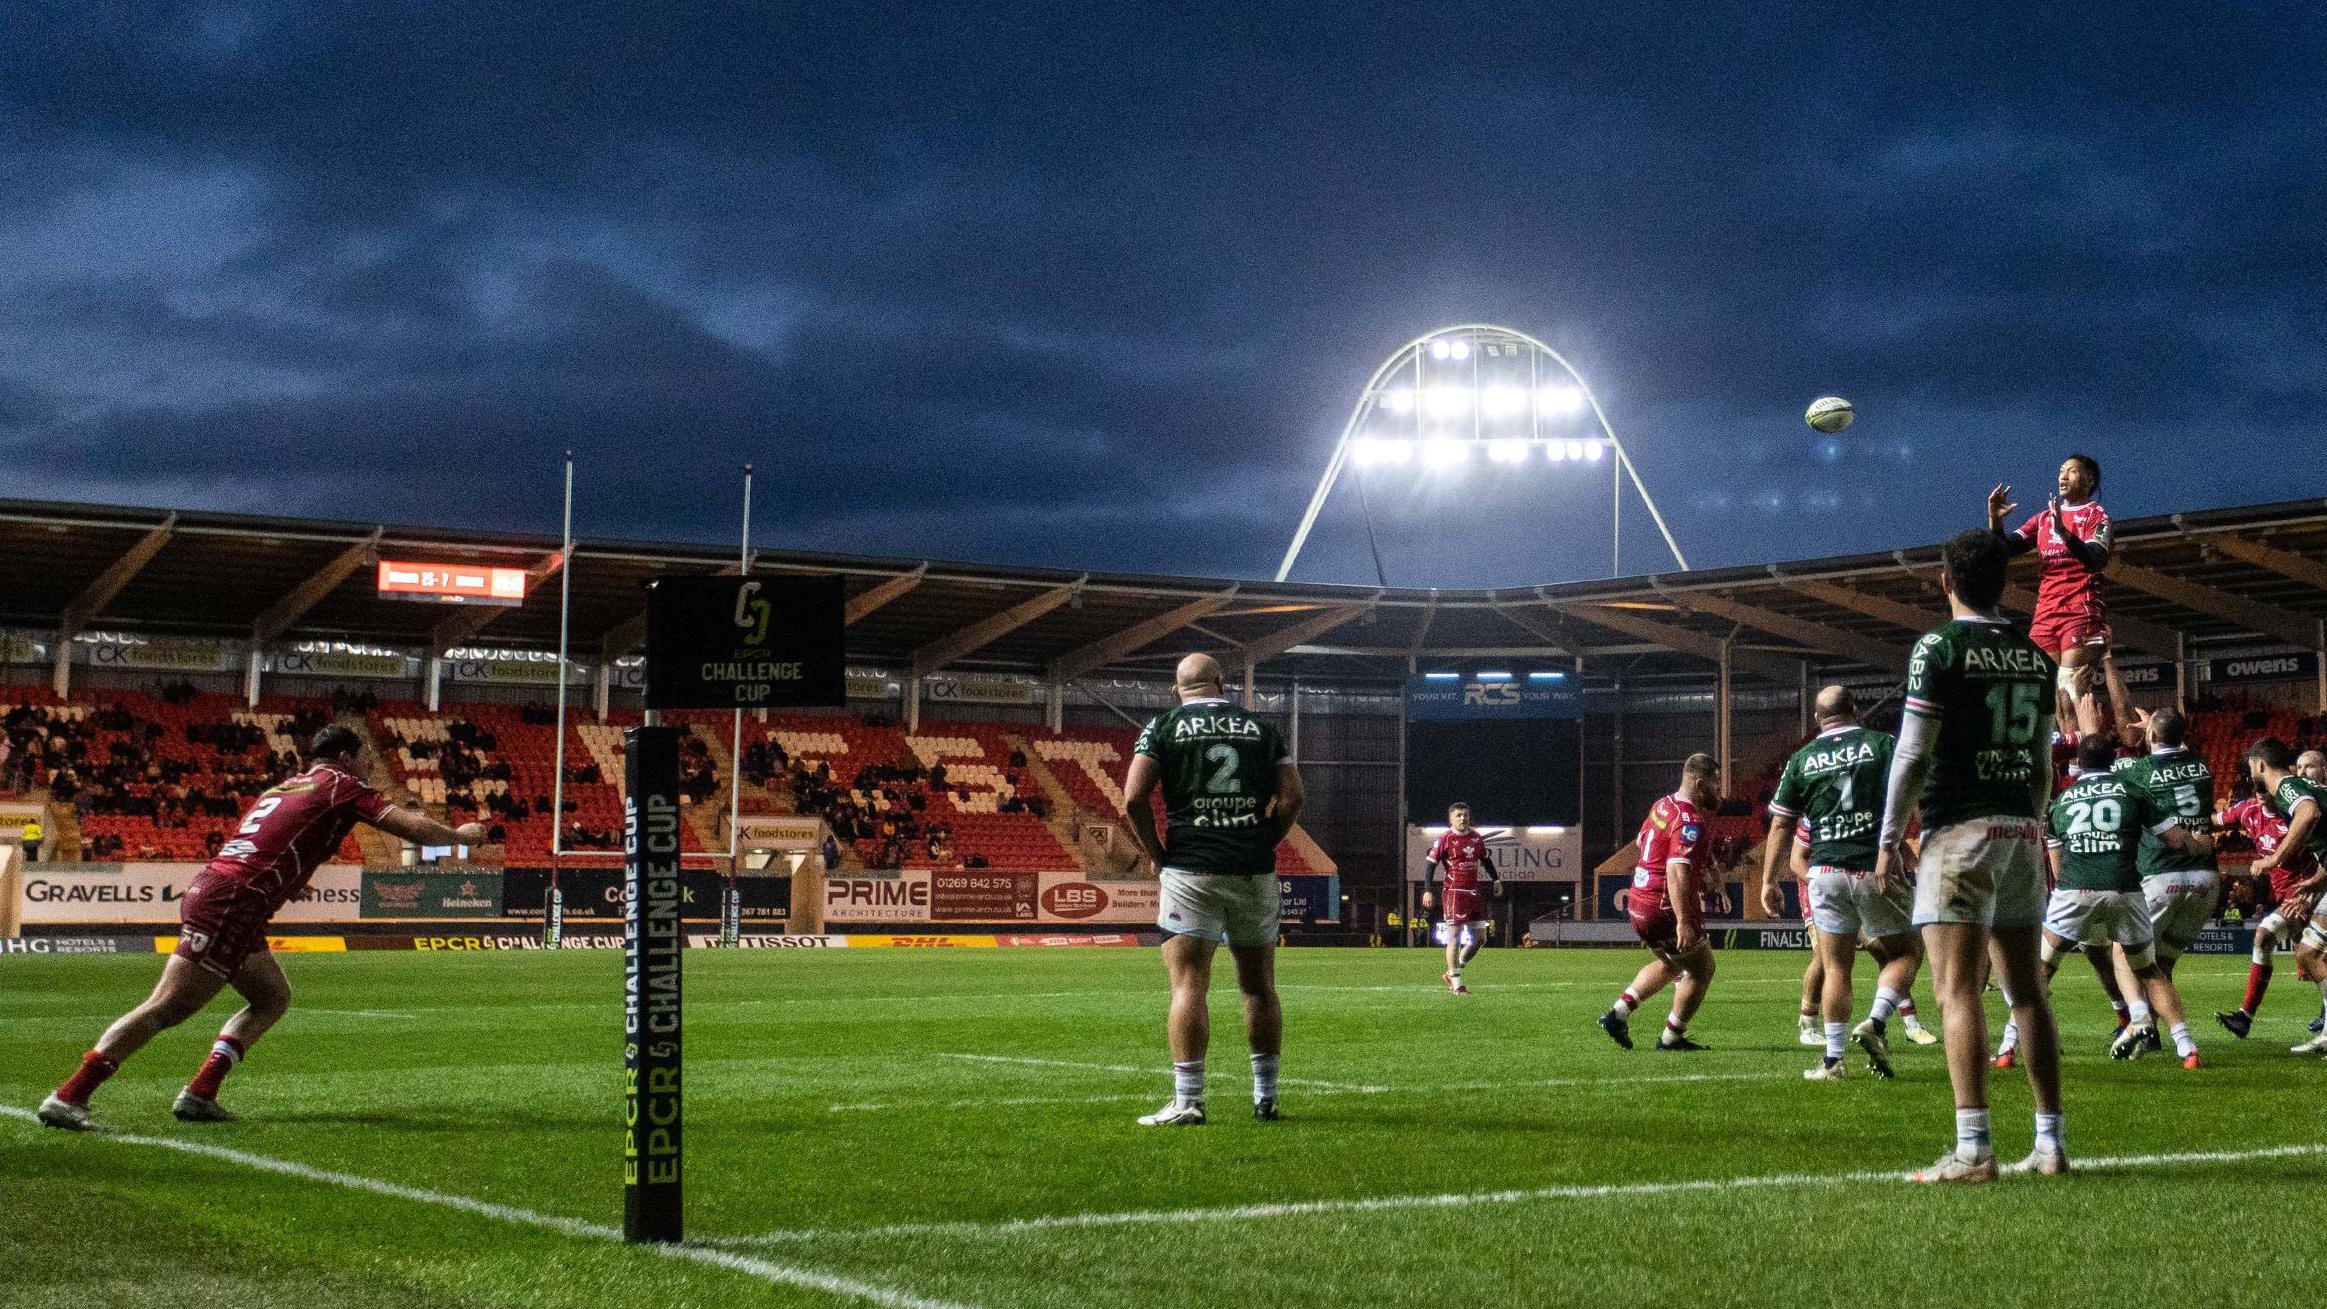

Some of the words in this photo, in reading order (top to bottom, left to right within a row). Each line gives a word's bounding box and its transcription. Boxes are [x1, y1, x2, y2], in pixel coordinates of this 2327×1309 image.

[1964, 647, 2048, 673] ARKEA
[2227, 657, 2299, 677] owens
[702, 663, 803, 681] CHALLENGE
[2092, 667, 2159, 685] oens
[735, 684, 771, 701] CUP
[1464, 683, 1520, 705] RCS
[1523, 692, 1550, 700] YOUR
[1552, 692, 1577, 700] WAY.
[1985, 685, 2039, 743] 15
[1175, 715, 1261, 737] ARKEA
[1804, 743, 1874, 771] ARKEA
[1206, 744, 1241, 793] 2
[2150, 762, 2209, 784] ARKEA
[2061, 783, 2127, 803] ARKEA
[2174, 785, 2200, 816] 5
[239, 797, 282, 834] 2
[625, 796, 638, 854] CUP
[647, 794, 677, 853] CUP
[2066, 799, 2121, 835] 20
[753, 826, 814, 839] foodstores
[2070, 838, 2121, 853] clim
[26, 880, 154, 902] GRAVELLS
[828, 881, 928, 905] PRIME
[937, 878, 967, 889] 01269
[992, 879, 1012, 889] 575
[442, 898, 492, 908] Heineken
[1054, 889, 1097, 903] LBS
[831, 909, 923, 918] ARCHITECTURE
[414, 937, 480, 951] EPCR
[593, 937, 626, 949] CUP
[625, 862, 638, 1034] CHALLENGE
[648, 861, 678, 1034] CHALLENGE
[741, 937, 830, 948] TISSOT
[891, 937, 955, 948] DHL
[1760, 931, 1801, 948] FINALS
[2193, 943, 2234, 952] RESORTS
[624, 1067, 638, 1185] EPCR
[648, 1066, 679, 1185] EPCR
